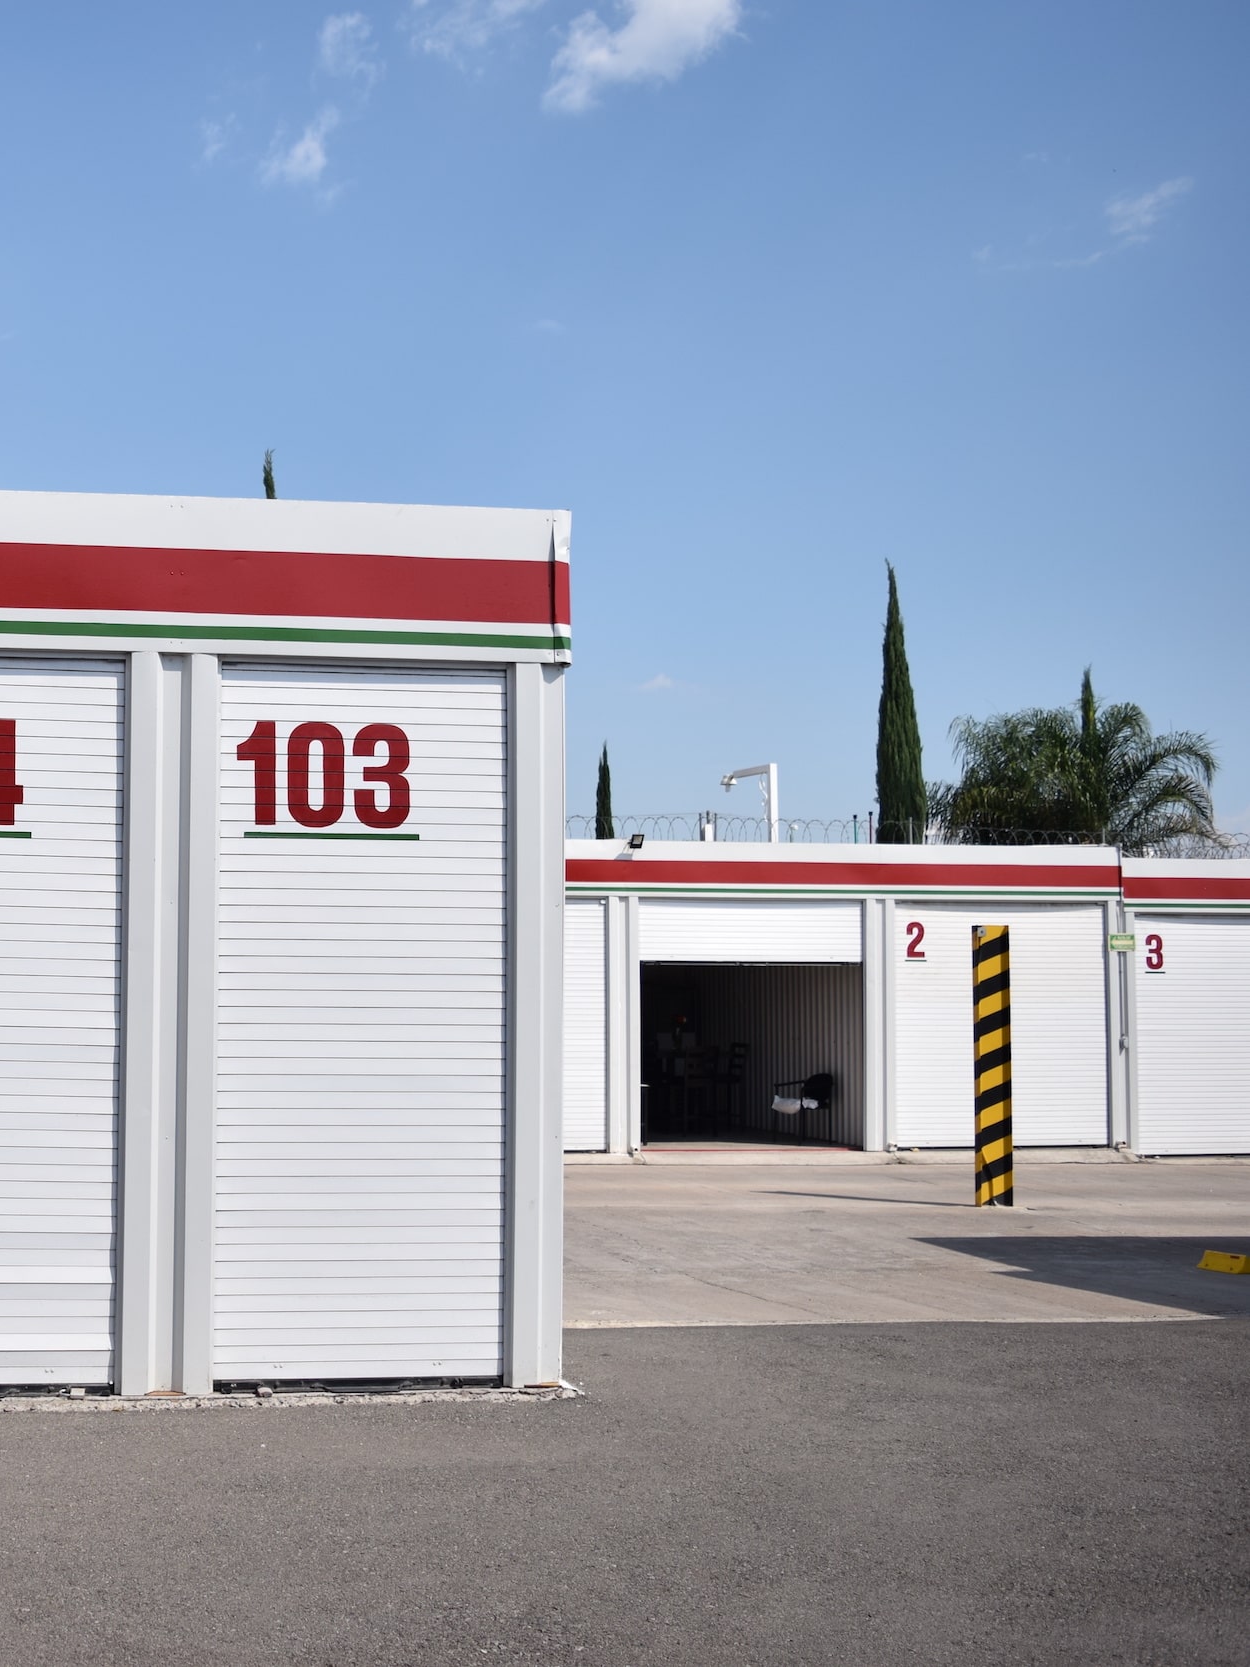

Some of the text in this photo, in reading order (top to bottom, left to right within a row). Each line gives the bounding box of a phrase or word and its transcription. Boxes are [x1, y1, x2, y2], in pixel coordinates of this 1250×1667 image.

[237, 722, 411, 829] 103
[907, 922, 925, 958] 2
[1145, 934, 1163, 970] 3
